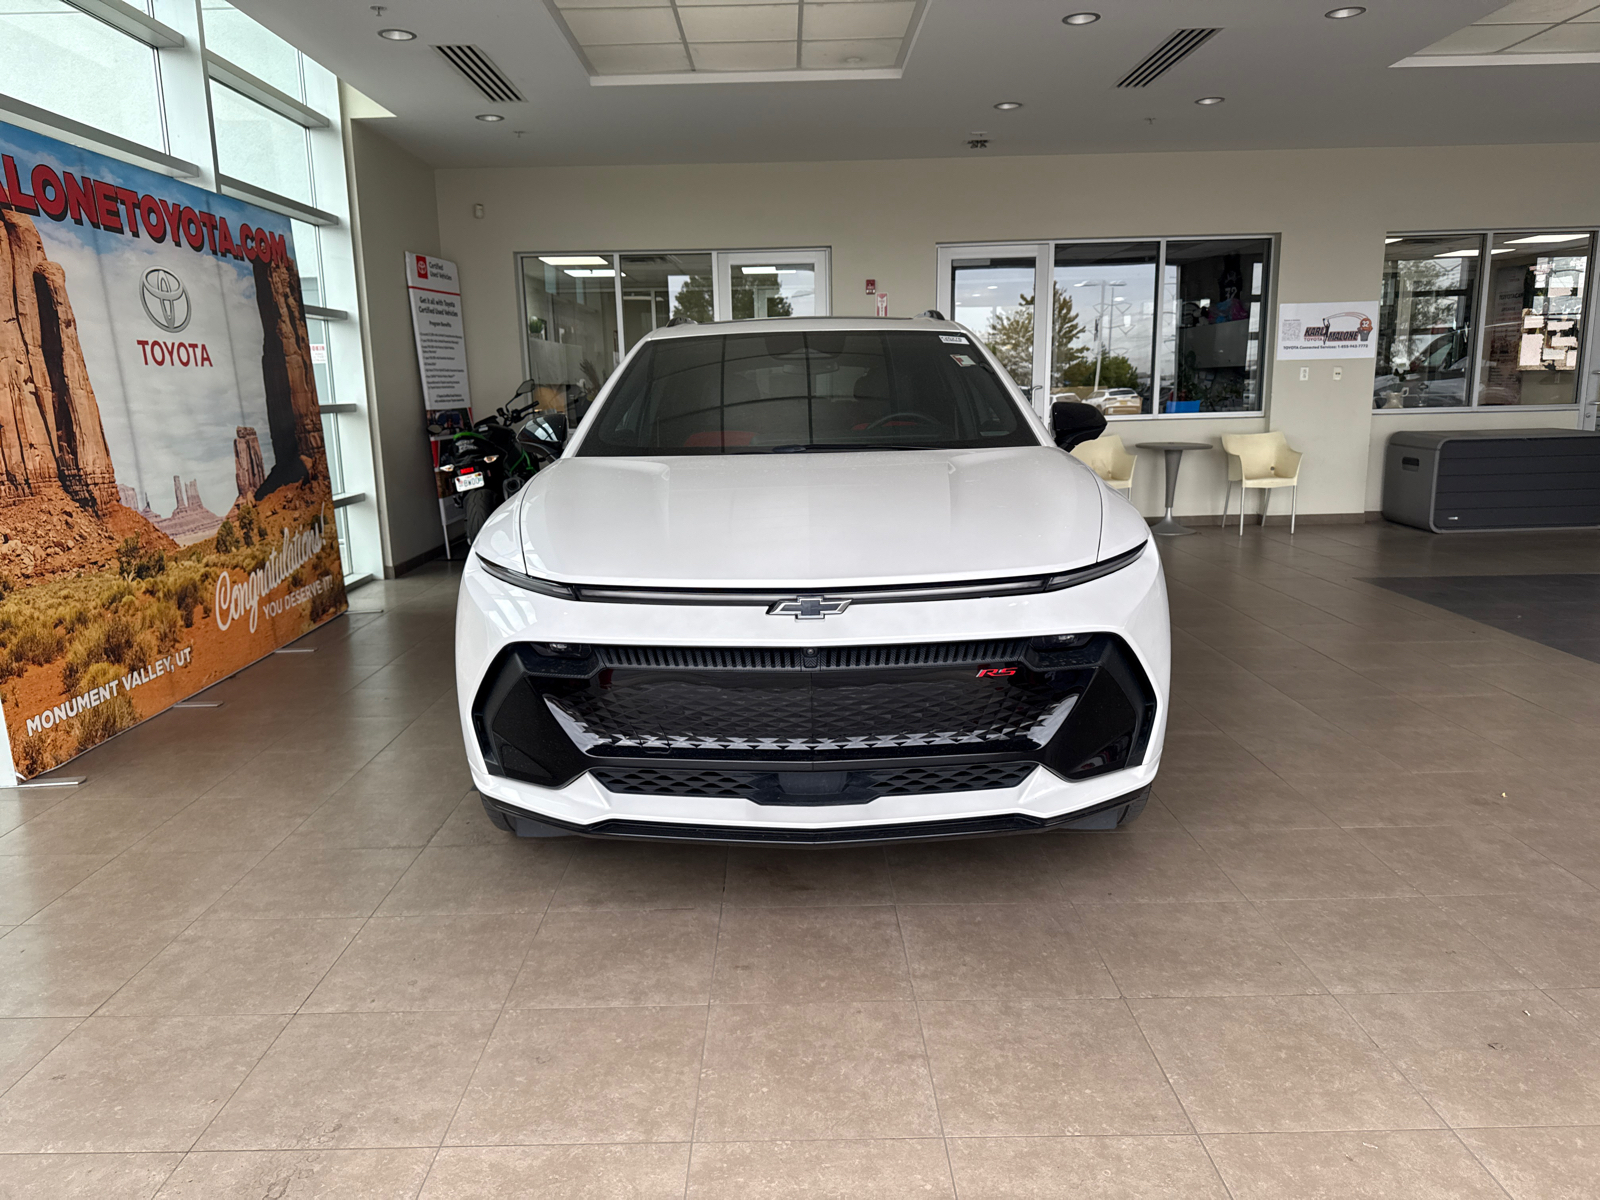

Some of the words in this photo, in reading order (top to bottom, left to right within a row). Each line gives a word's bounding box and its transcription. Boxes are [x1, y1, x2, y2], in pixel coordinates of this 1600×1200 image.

[137, 340, 213, 367] TOYOTA
[1327, 331, 1359, 342] MALONE
[215, 501, 326, 634] Congratulations!
[263, 598, 283, 619] YOU
[284, 580, 323, 610] DESERVE
[323, 574, 334, 591] IT!
[976, 667, 1018, 678] RS
[25, 679, 119, 737] MONUMENT
[121, 655, 175, 691] VALLEY,
[175, 647, 191, 667] UT
